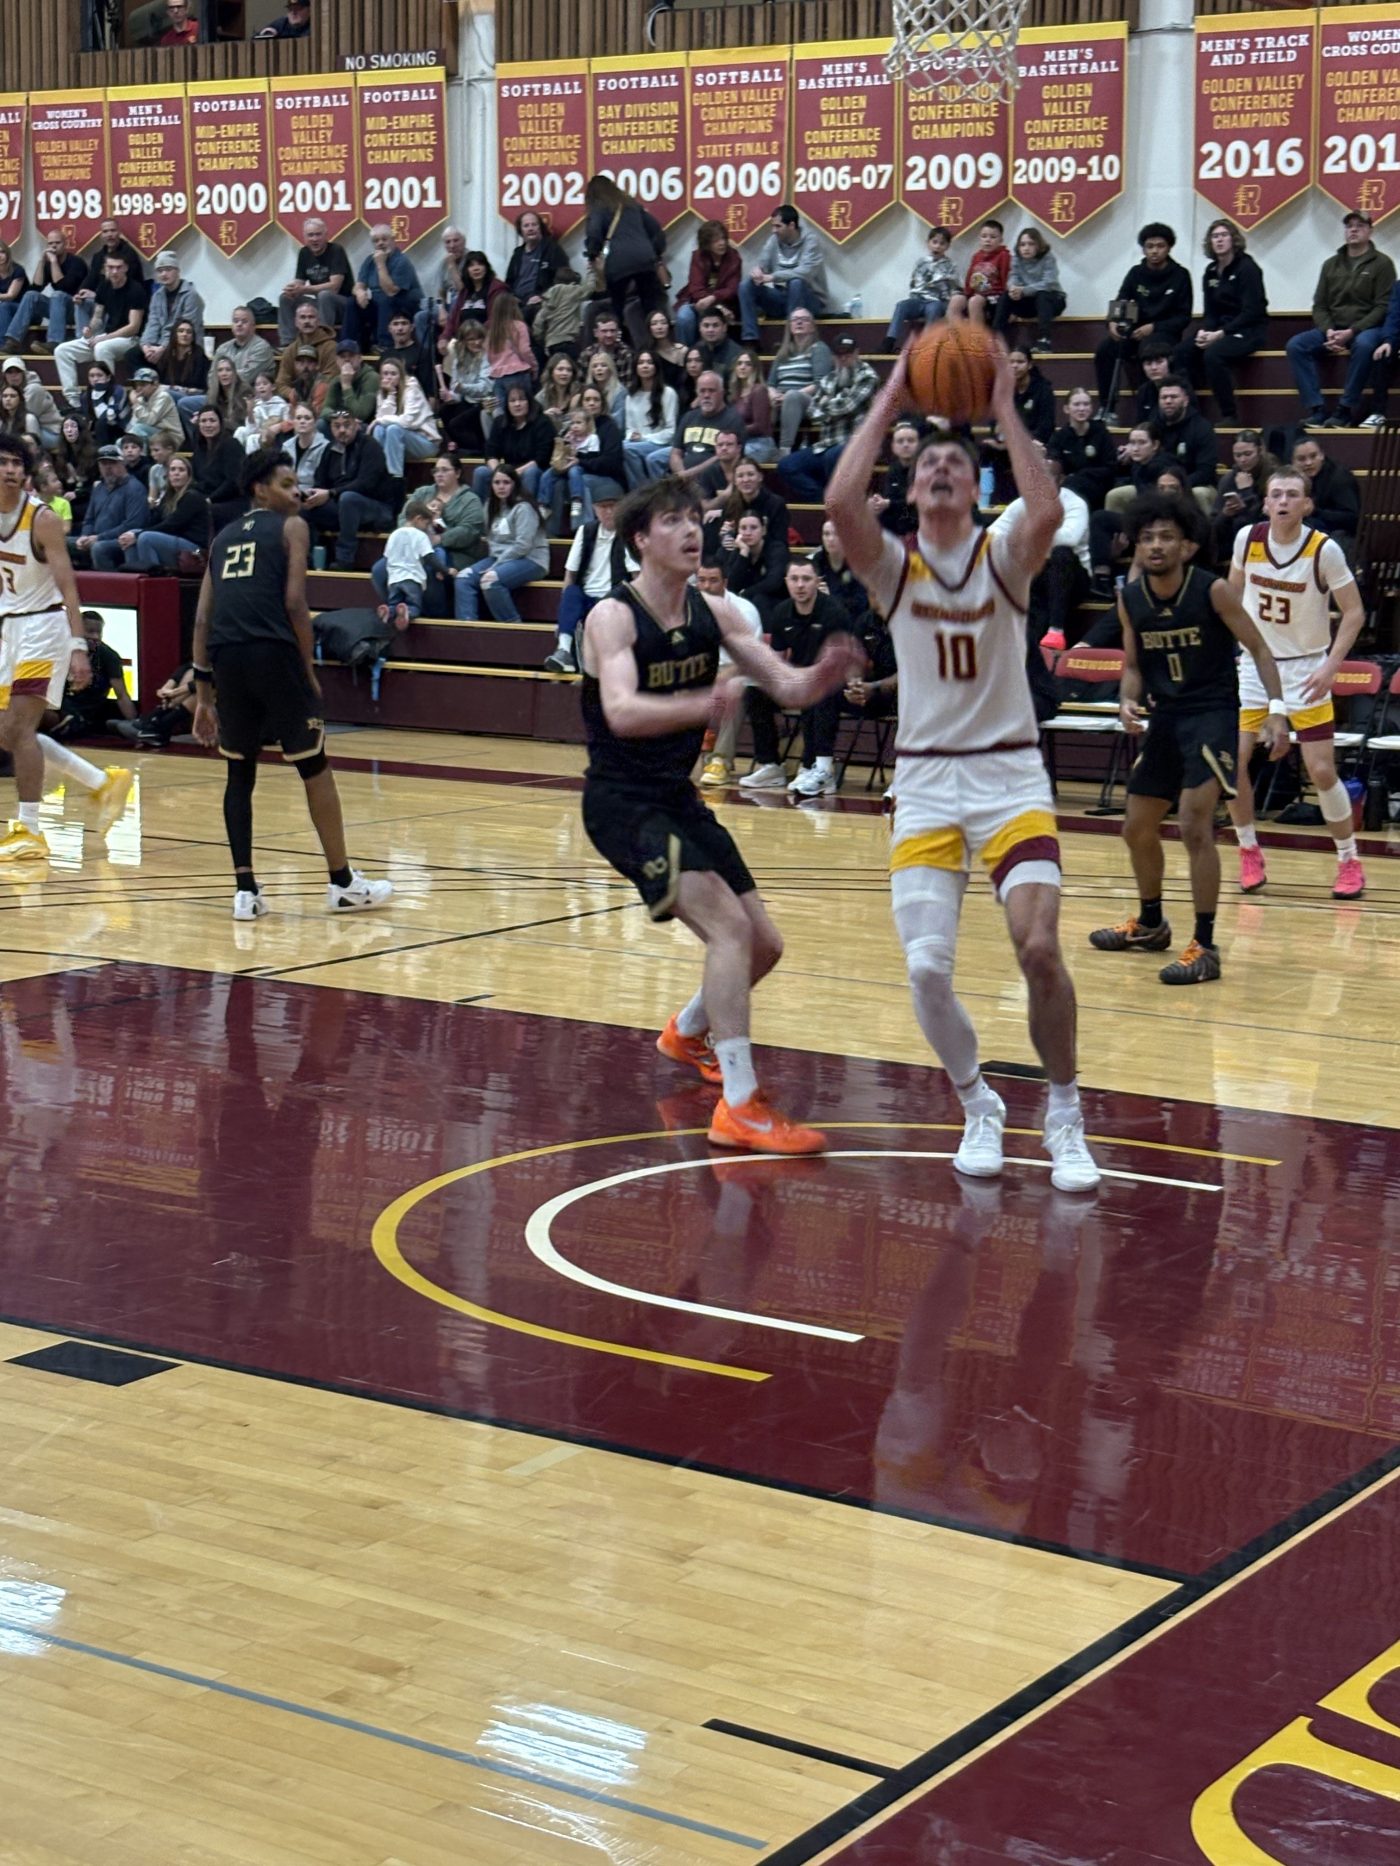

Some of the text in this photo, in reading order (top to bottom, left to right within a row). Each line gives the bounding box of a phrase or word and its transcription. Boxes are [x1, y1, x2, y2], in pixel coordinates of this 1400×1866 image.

[1200, 34, 1310, 52] MEN'S TRACK
[1322, 45, 1367, 57] CROSS
[345, 51, 437, 70] NO SMOKING
[1043, 48, 1094, 62] MEN'S
[1210, 50, 1297, 66] AND FIELD
[821, 62, 868, 75] MEN'S
[1018, 61, 1119, 78] BASKETBALL
[598, 74, 679, 91] FOOTBALL
[695, 69, 783, 86] SOFTBALL
[798, 73, 891, 90] BASKETBALL
[1202, 74, 1305, 94] GOLDEN VALLEY
[1326, 70, 1378, 87] GOLDEN
[363, 89, 437, 104] FOOTBALL
[501, 81, 582, 98] SOFTBALL
[693, 87, 785, 106] GOLDEN VALLEY
[1042, 83, 1093, 99] GOLDEN
[193, 99, 261, 113] FOOTBALL
[275, 94, 349, 110] SOFTBALL
[518, 102, 565, 118] GOLDEN
[598, 101, 679, 120] BAY DIVISION
[820, 95, 867, 111] GOLDEN
[1043, 100, 1091, 116] VALLEY
[1210, 93, 1295, 111] CONFERENCE
[701, 104, 777, 120] CONFERENCE
[820, 112, 865, 127] VALLEY
[908, 102, 999, 121] CONFERENCE
[111, 115, 181, 128] BASKETBALL
[291, 114, 333, 129] GOLDEN
[366, 114, 435, 130] MID-EMPIRE
[518, 119, 564, 134] VALLEY
[599, 119, 679, 137] CONFERENCE
[704, 120, 773, 136] CHAMPIONS
[1024, 117, 1109, 134] CONFERENCE
[1213, 112, 1290, 130] CHAMPIONS
[291, 130, 333, 144] VALLEY
[804, 127, 881, 144] CONFERENCE
[912, 121, 995, 140] CHAMPIONS
[194, 139, 261, 155] CONFERENCE
[364, 132, 437, 147] CONFERENCE
[503, 134, 581, 151] CONFERENCE
[602, 138, 675, 155] CHAMPIONS
[1027, 134, 1104, 151] CHAMPIONS
[278, 144, 348, 160] CONFERENCE
[367, 149, 434, 164] CHAMPIONS
[697, 141, 779, 159] STATE FINAL 8
[807, 144, 878, 161] CHAMPIONS
[1199, 138, 1304, 179] 2016
[506, 151, 578, 167] CHAMPIONS
[281, 160, 345, 176] CHAMPIONS
[905, 152, 1003, 191] 2009
[1013, 154, 1120, 184] 2009-10
[694, 161, 781, 199] 2006
[794, 164, 894, 192] 2006-07
[278, 180, 352, 213] 2001
[365, 177, 442, 210] 2001
[502, 171, 585, 207] 2002
[37, 189, 102, 220] 1998
[112, 192, 187, 216] 1998-99
[195, 182, 267, 215] 2000
[221, 541, 256, 580] 23
[1258, 593, 1291, 624] 23
[1140, 627, 1201, 649] BUTTE
[935, 631, 977, 681] 10
[1167, 653, 1184, 682] 0
